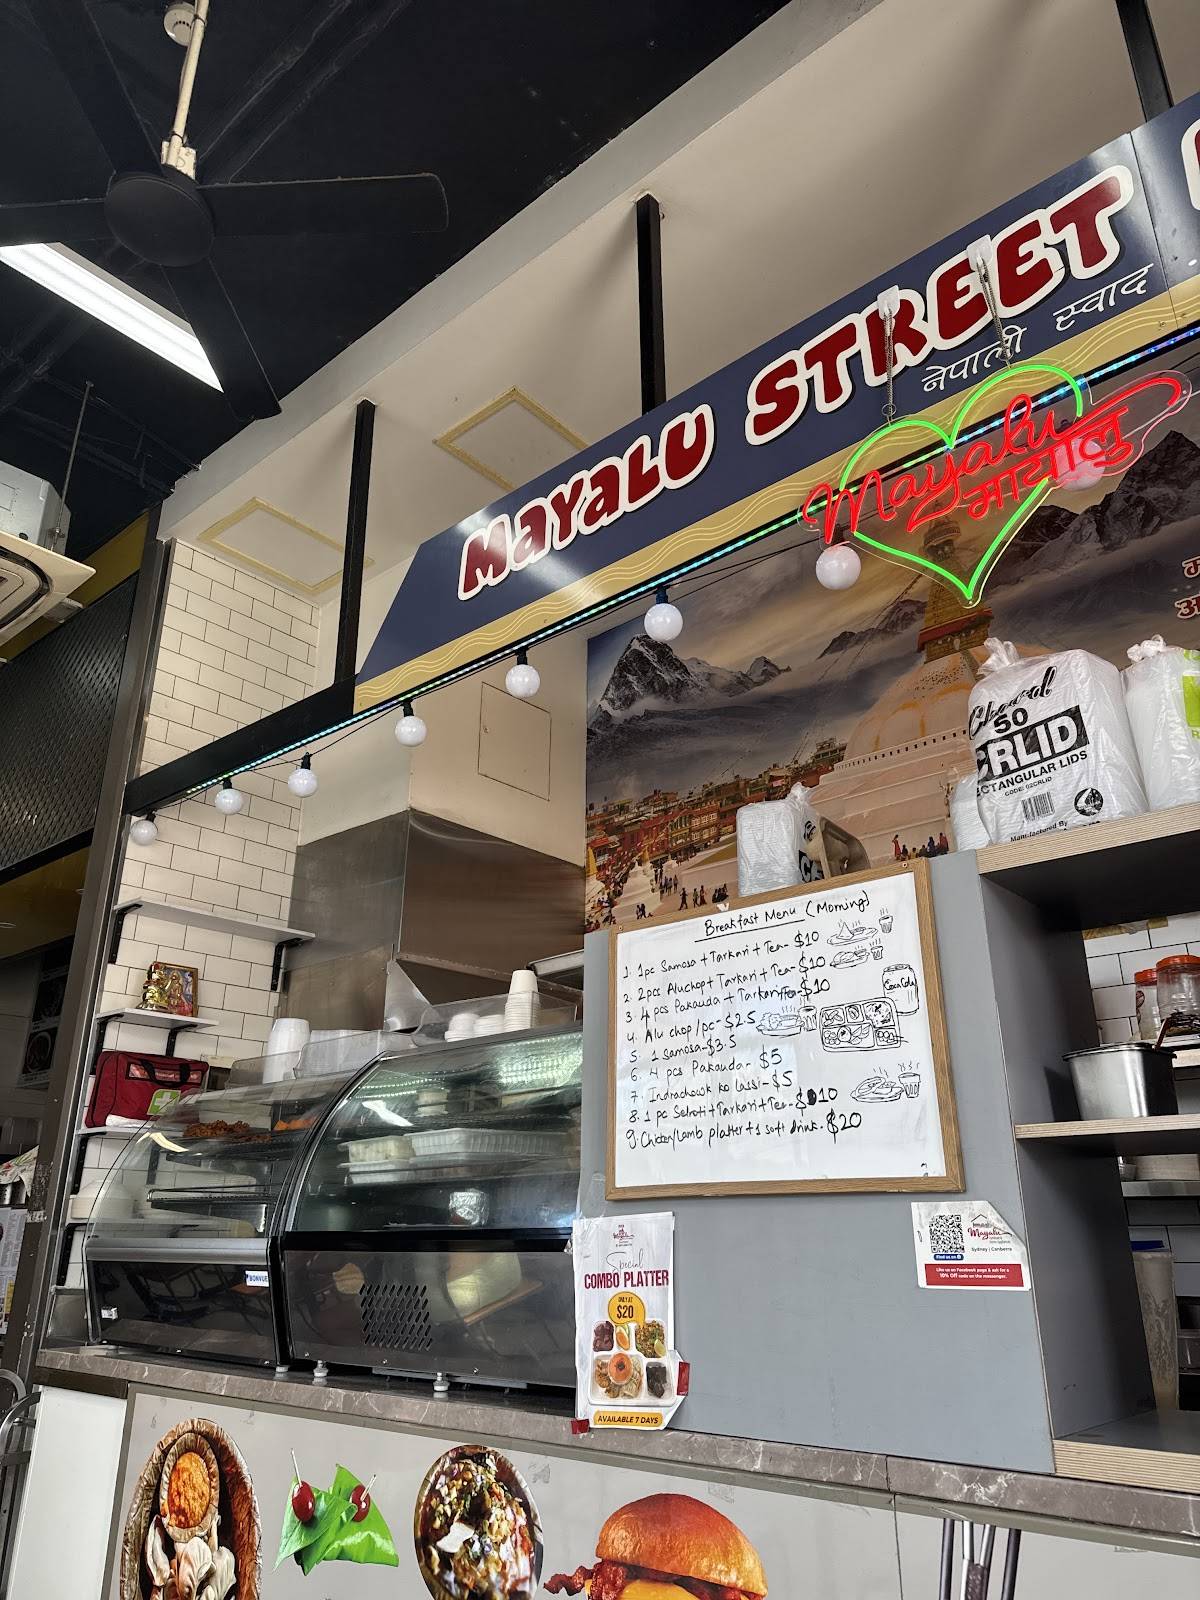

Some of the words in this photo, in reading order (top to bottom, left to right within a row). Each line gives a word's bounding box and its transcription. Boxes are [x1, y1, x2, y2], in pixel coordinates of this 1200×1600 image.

[746, 166, 1133, 447] STREET
[1053, 263, 1154, 331] स्वाद
[802, 390, 1110, 546] Mayalu
[993, 707, 1029, 734] 50
[1059, 750, 1088, 769] LIDS
[704, 912, 758, 936] Breakfast
[765, 907, 796, 922] Menu
[805, 890, 870, 917] (Morning)
[661, 959, 697, 973] Samosa
[794, 929, 820, 949] $10
[716, 970, 757, 988] Tarkari
[798, 951, 826, 975] $10
[641, 1006, 650, 1030] 4
[645, 1029, 664, 1043] Alu
[670, 1024, 692, 1042] chop
[651, 1050, 659, 1062] 1
[760, 1044, 783, 1070] $5
[772, 1069, 793, 1091] $5
[644, 1110, 651, 1122] 1
[708, 1122, 743, 1148] platter
[766, 1120, 785, 1137] soft
[826, 1107, 862, 1144] $20
[606, 1248, 643, 1275] Special
[584, 1271, 620, 1289] COMBO
[624, 1269, 669, 1288] PLATTER
[616, 1304, 634, 1319] $20
[597, 1415, 634, 1424] AVAILABLE
[635, 1415, 640, 1424] 7
[640, 1416, 659, 1425] DAYS
